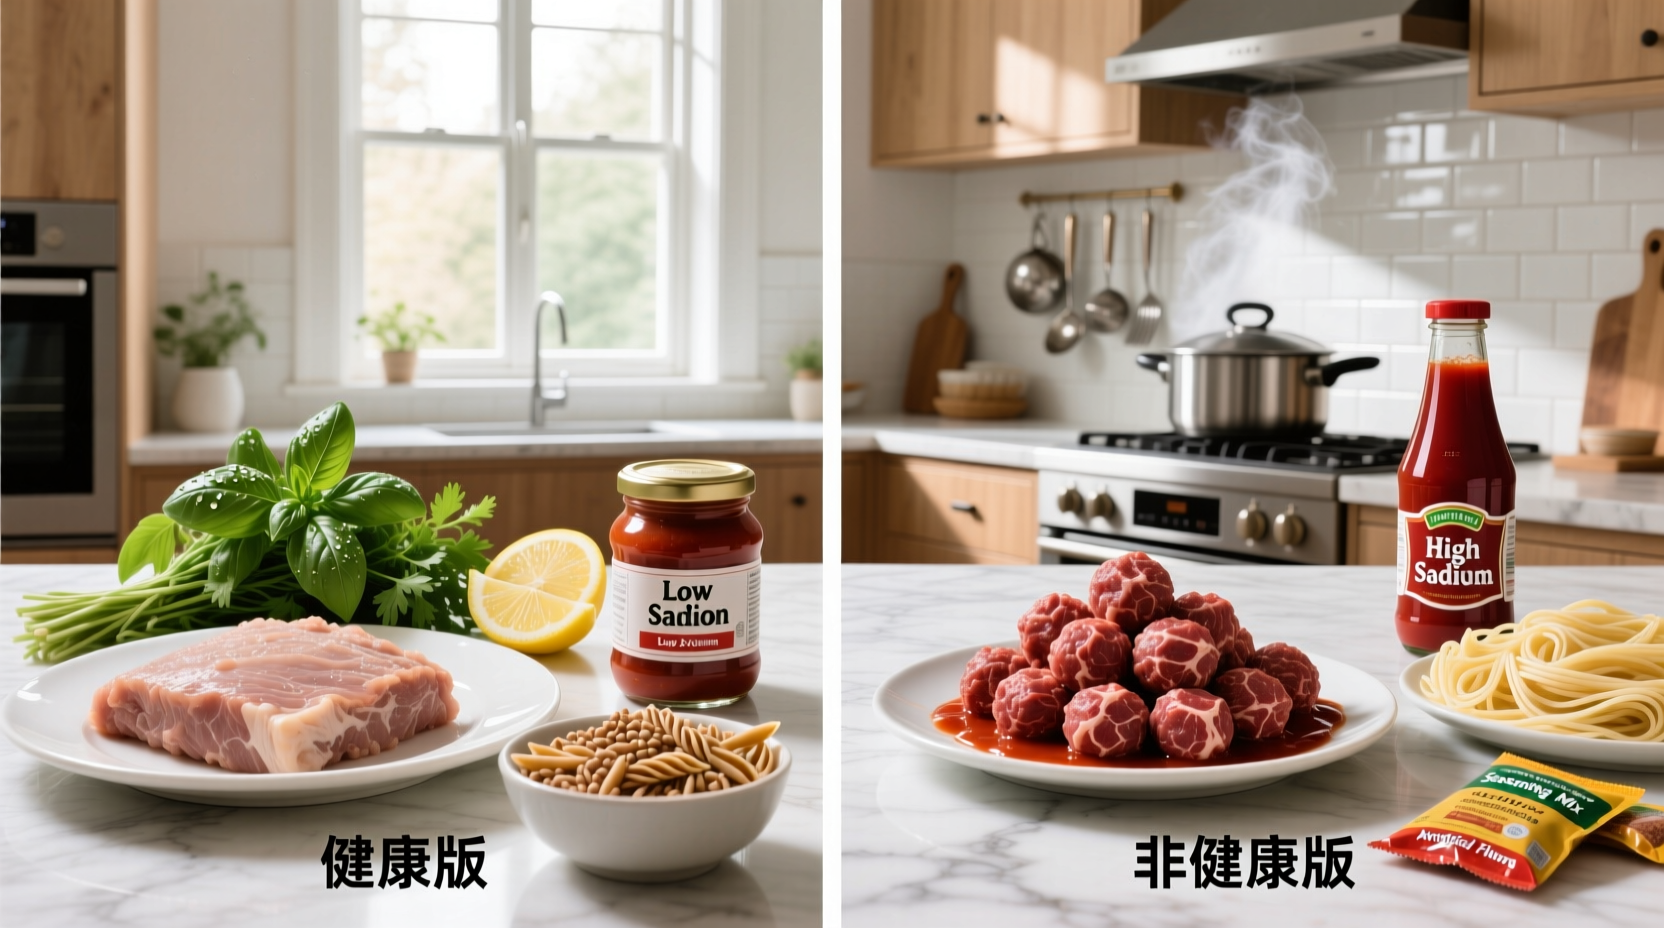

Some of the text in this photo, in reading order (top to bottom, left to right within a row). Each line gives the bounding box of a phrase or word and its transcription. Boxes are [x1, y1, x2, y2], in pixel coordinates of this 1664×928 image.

[1425, 536, 1480, 566] High
[1414, 561, 1494, 586] Sadium
[662, 580, 713, 601] Low
[648, 603, 729, 626] Sadion
